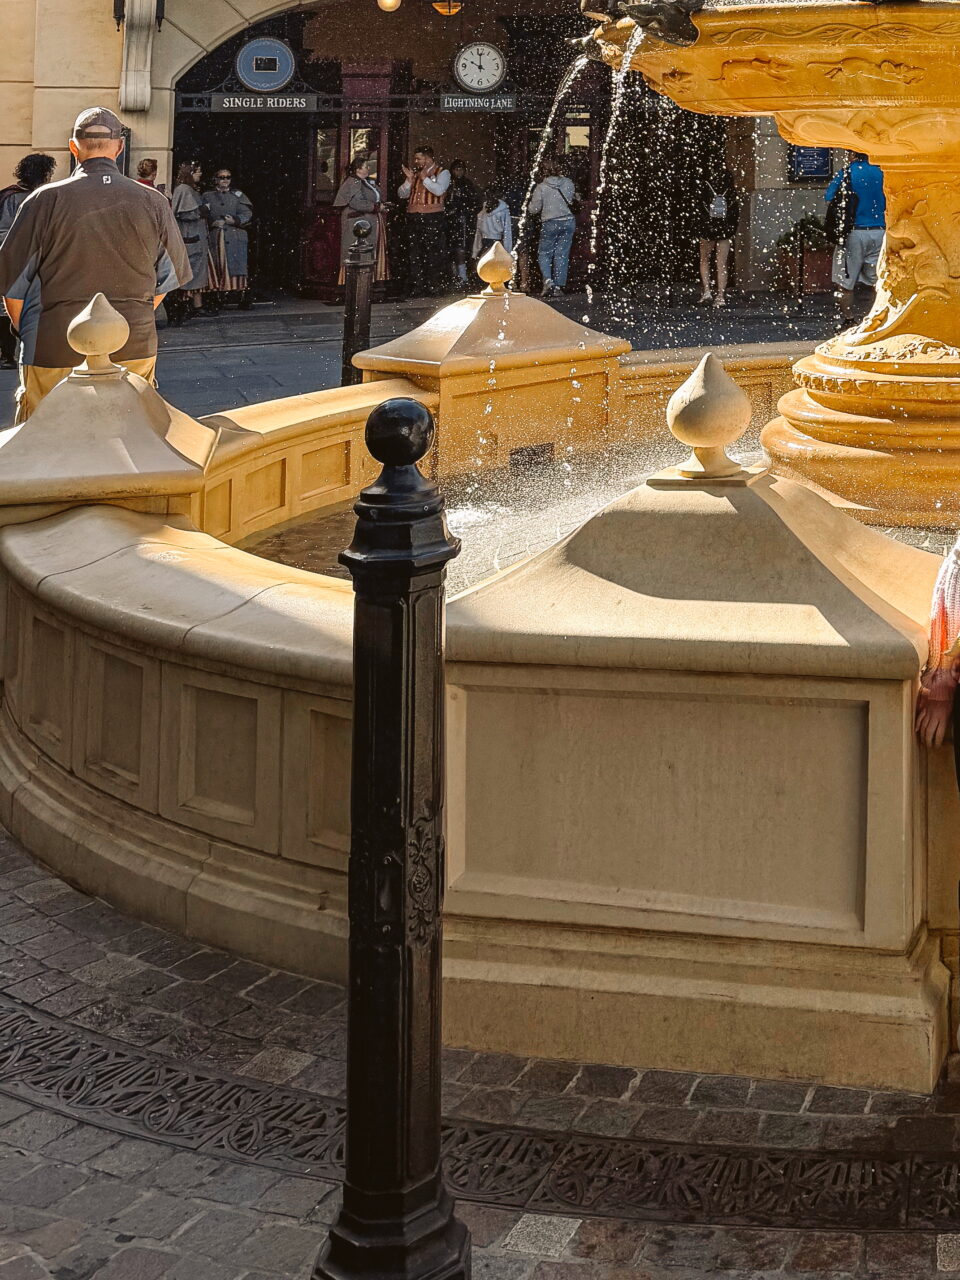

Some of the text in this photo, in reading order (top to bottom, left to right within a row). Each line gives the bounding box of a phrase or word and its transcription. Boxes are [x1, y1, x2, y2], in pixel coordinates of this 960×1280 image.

[461, 62, 467, 71] 9
[477, 78, 483, 86] 6
[222, 97, 306, 108] SINGLE RIDERS
[444, 97, 513, 109] LIGHTNING LANE
